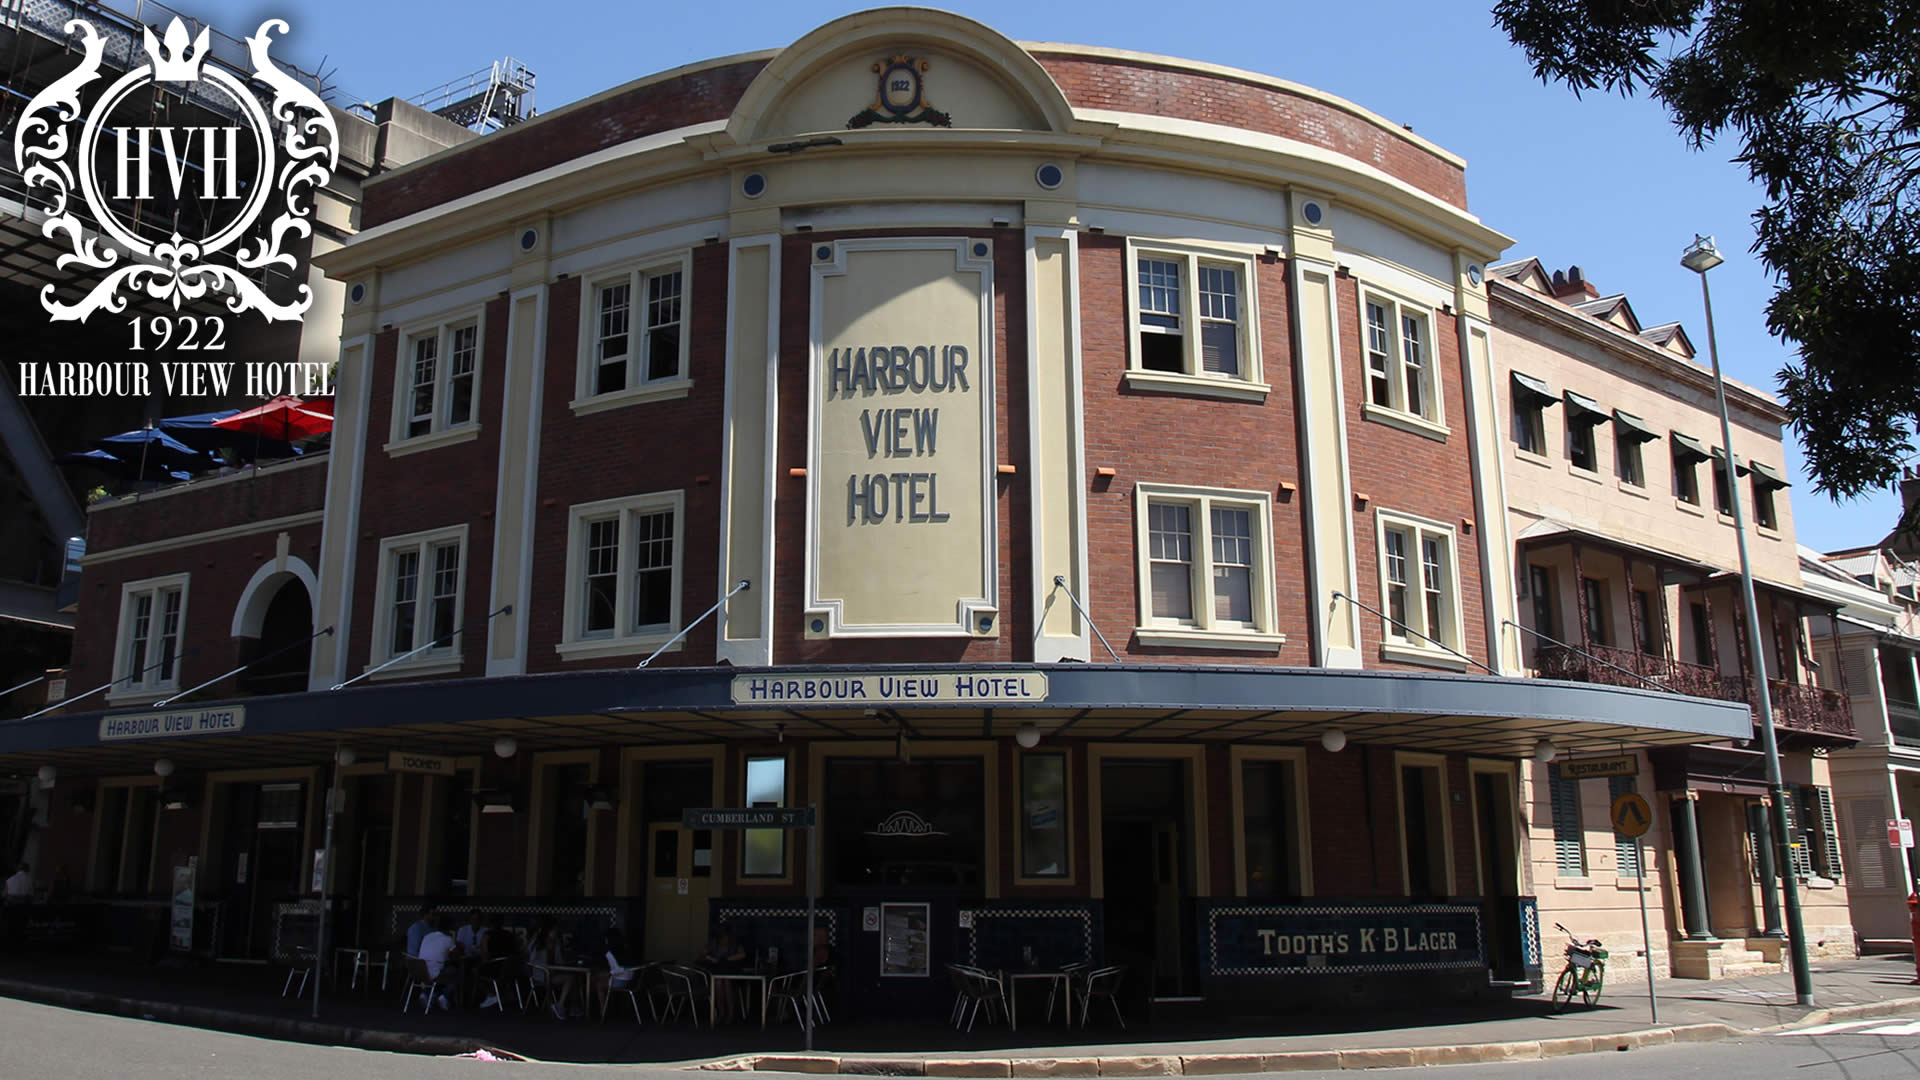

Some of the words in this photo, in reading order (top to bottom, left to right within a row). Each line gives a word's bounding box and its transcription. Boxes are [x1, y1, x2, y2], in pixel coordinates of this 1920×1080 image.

[891, 80, 910, 92] 1922
[830, 345, 970, 396] HARBOUR
[861, 408, 939, 458] VIEW
[848, 473, 950, 525] HOTEL
[750, 679, 867, 699] HARBOUR
[879, 677, 939, 698] VIEW
[956, 676, 1031, 697] HOTEL
[107, 719, 159, 736] HARBOUR
[164, 715, 193, 732] VIEW
[200, 711, 235, 729] HOTEL
[701, 813, 774, 824] CUMBERLAND
[781, 813, 795, 824] ST
[1257, 929, 1349, 955] TOOTH'S
[1403, 927, 1457, 951] LAGER
